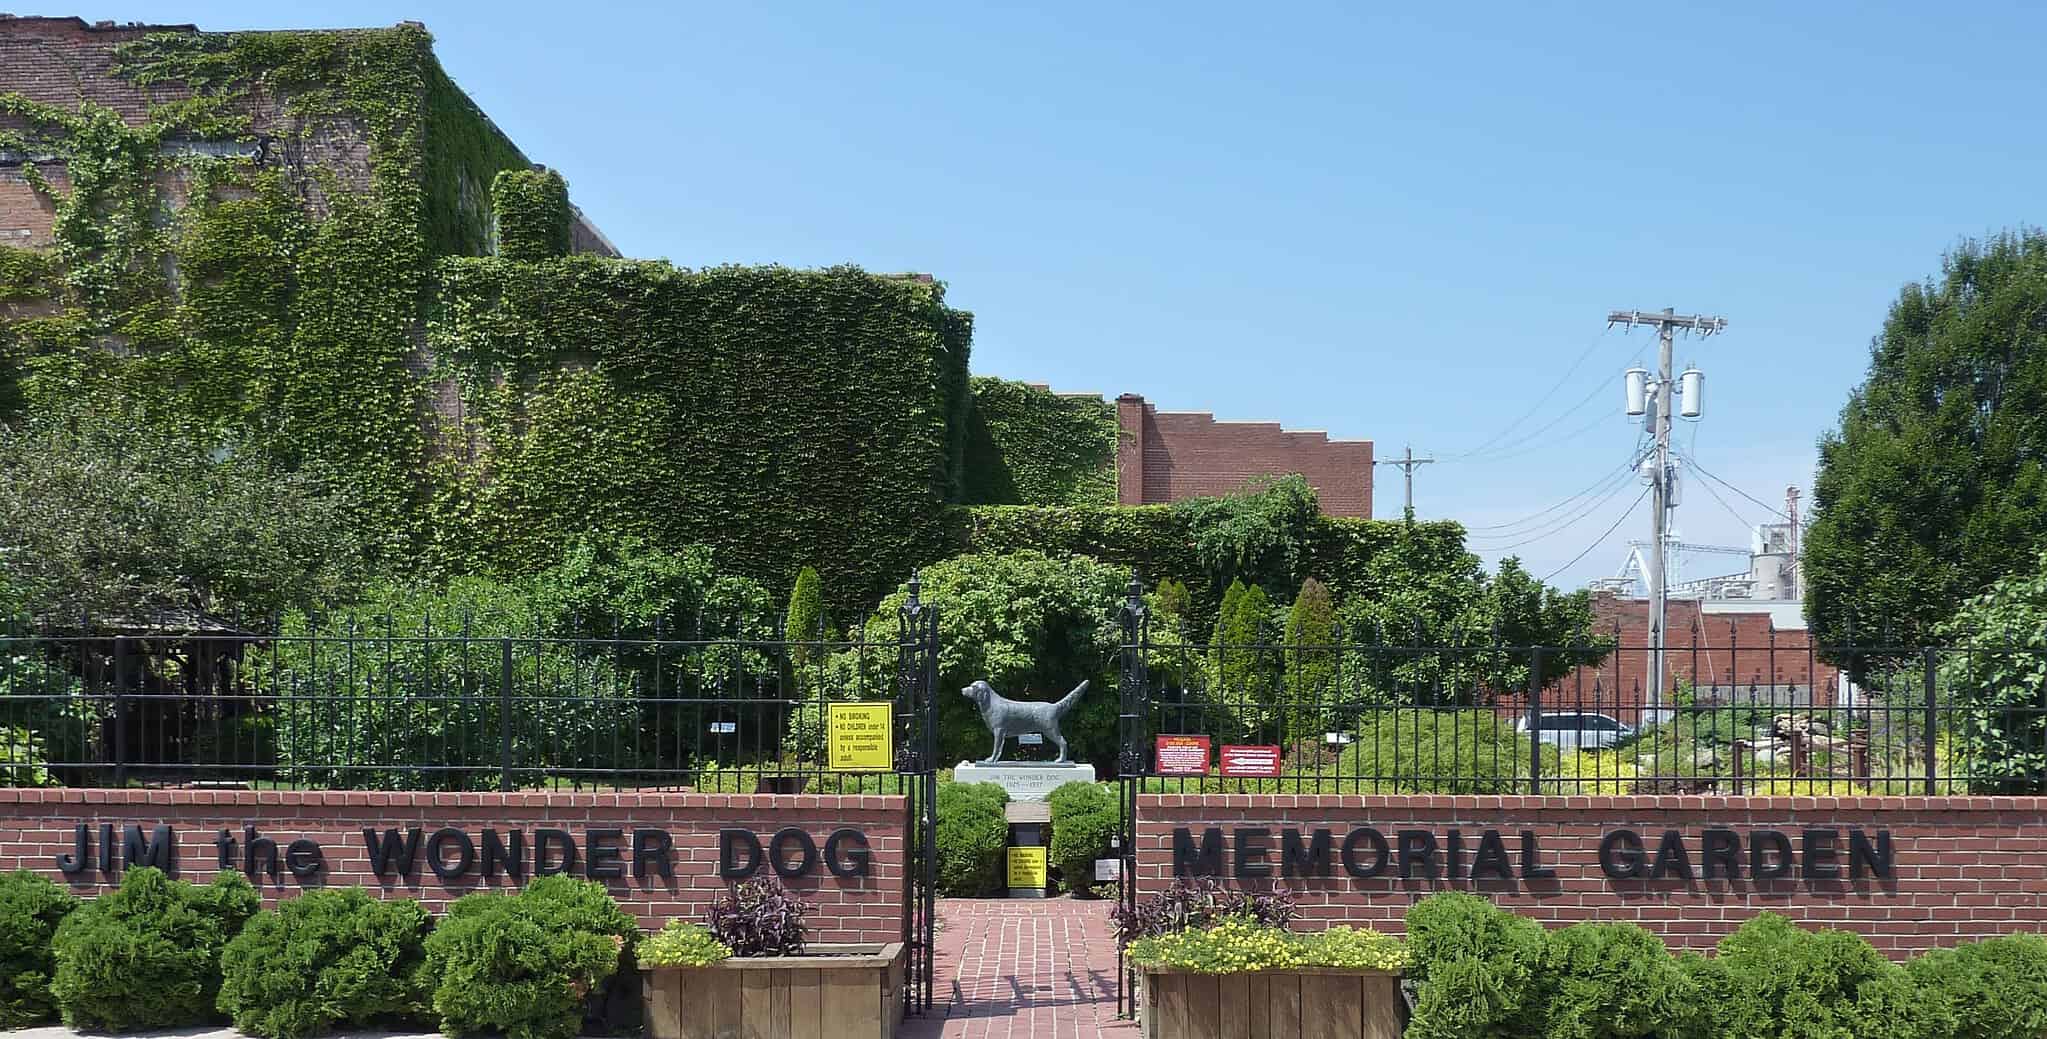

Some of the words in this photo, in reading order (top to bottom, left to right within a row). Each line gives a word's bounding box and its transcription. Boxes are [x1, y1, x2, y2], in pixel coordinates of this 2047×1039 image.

[840, 712, 846, 720] NO
[849, 712, 870, 720] SMOKING
[56, 823, 173, 873] JIM
[214, 824, 322, 877] the
[362, 826, 674, 879] WONDER
[719, 826, 871, 878] DOG
[1172, 827, 1556, 879] MEMORIAL
[1597, 827, 1892, 879] GARDEN
